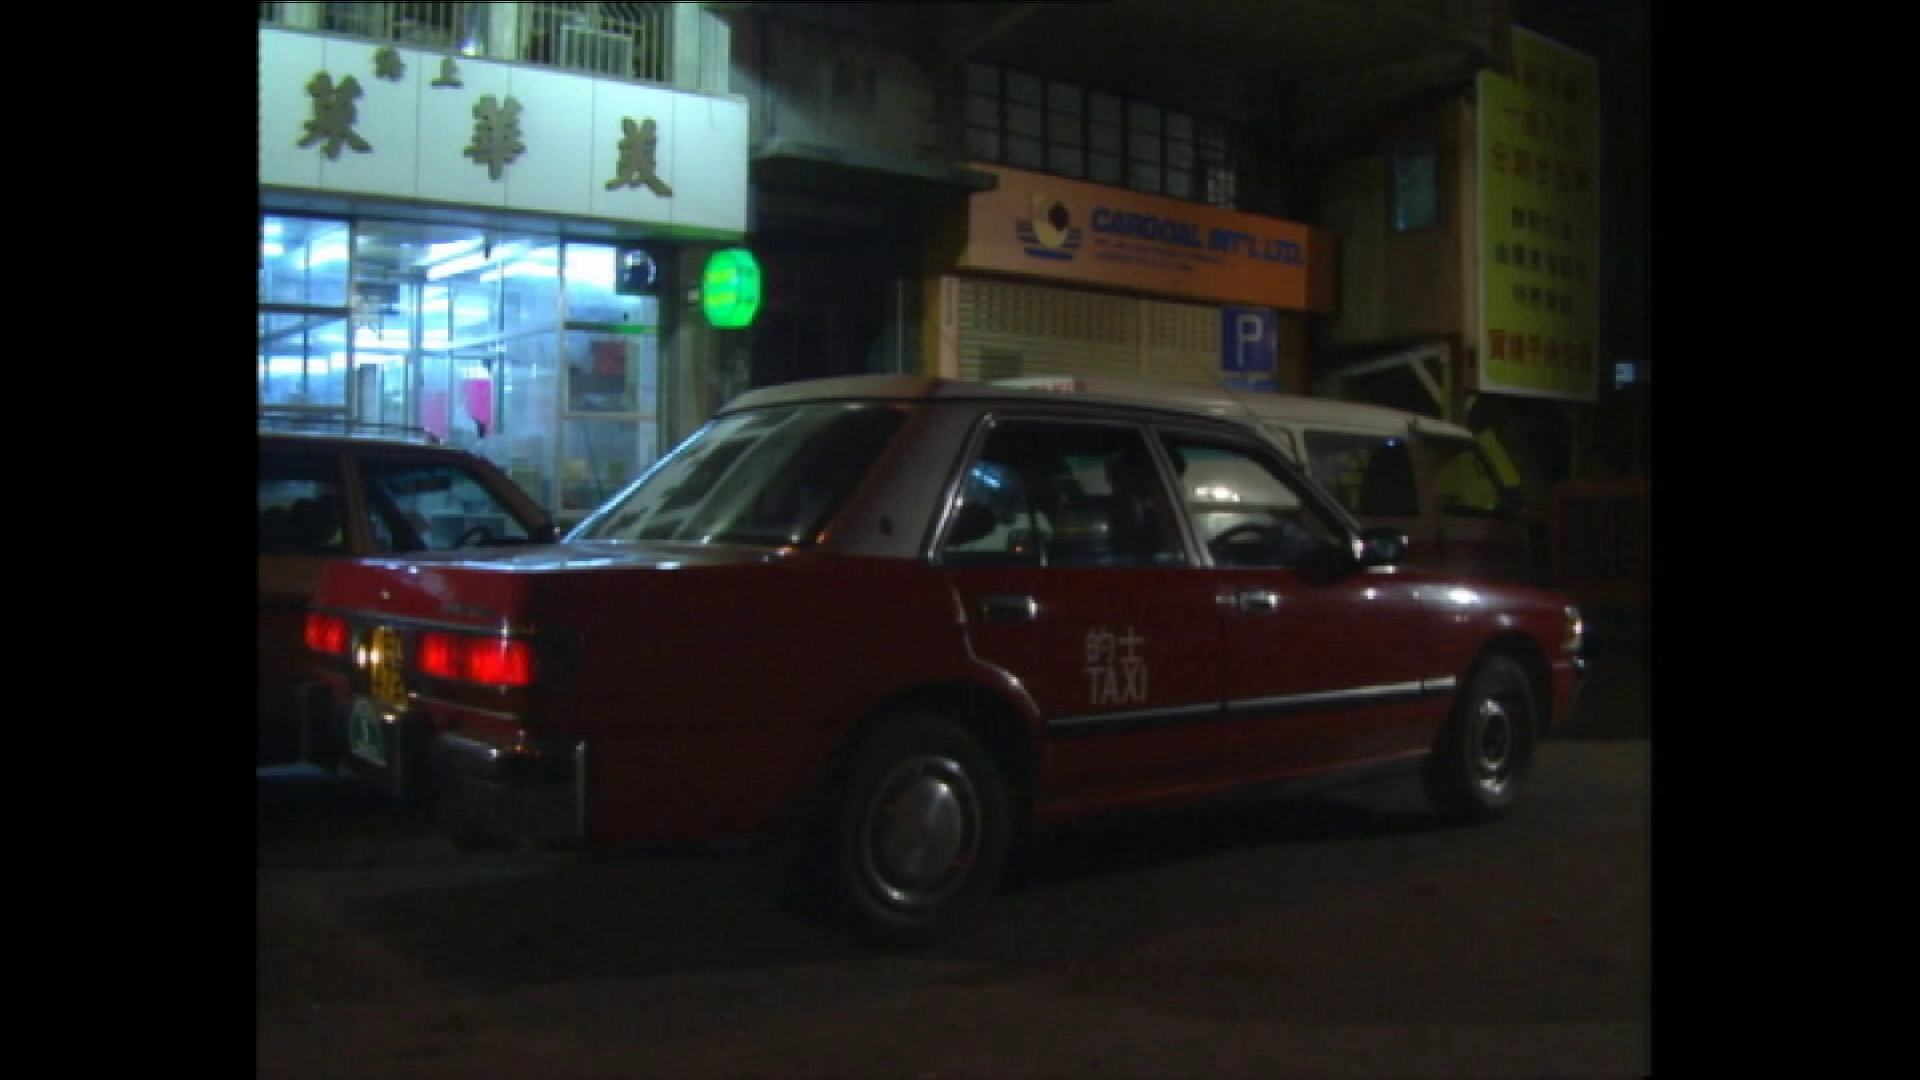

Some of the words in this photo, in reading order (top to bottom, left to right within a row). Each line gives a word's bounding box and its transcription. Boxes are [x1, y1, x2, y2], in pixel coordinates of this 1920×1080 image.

[1236, 313, 1264, 369] P
[1086, 625, 1145, 664] 的士
[1087, 662, 1148, 704] TAXI
